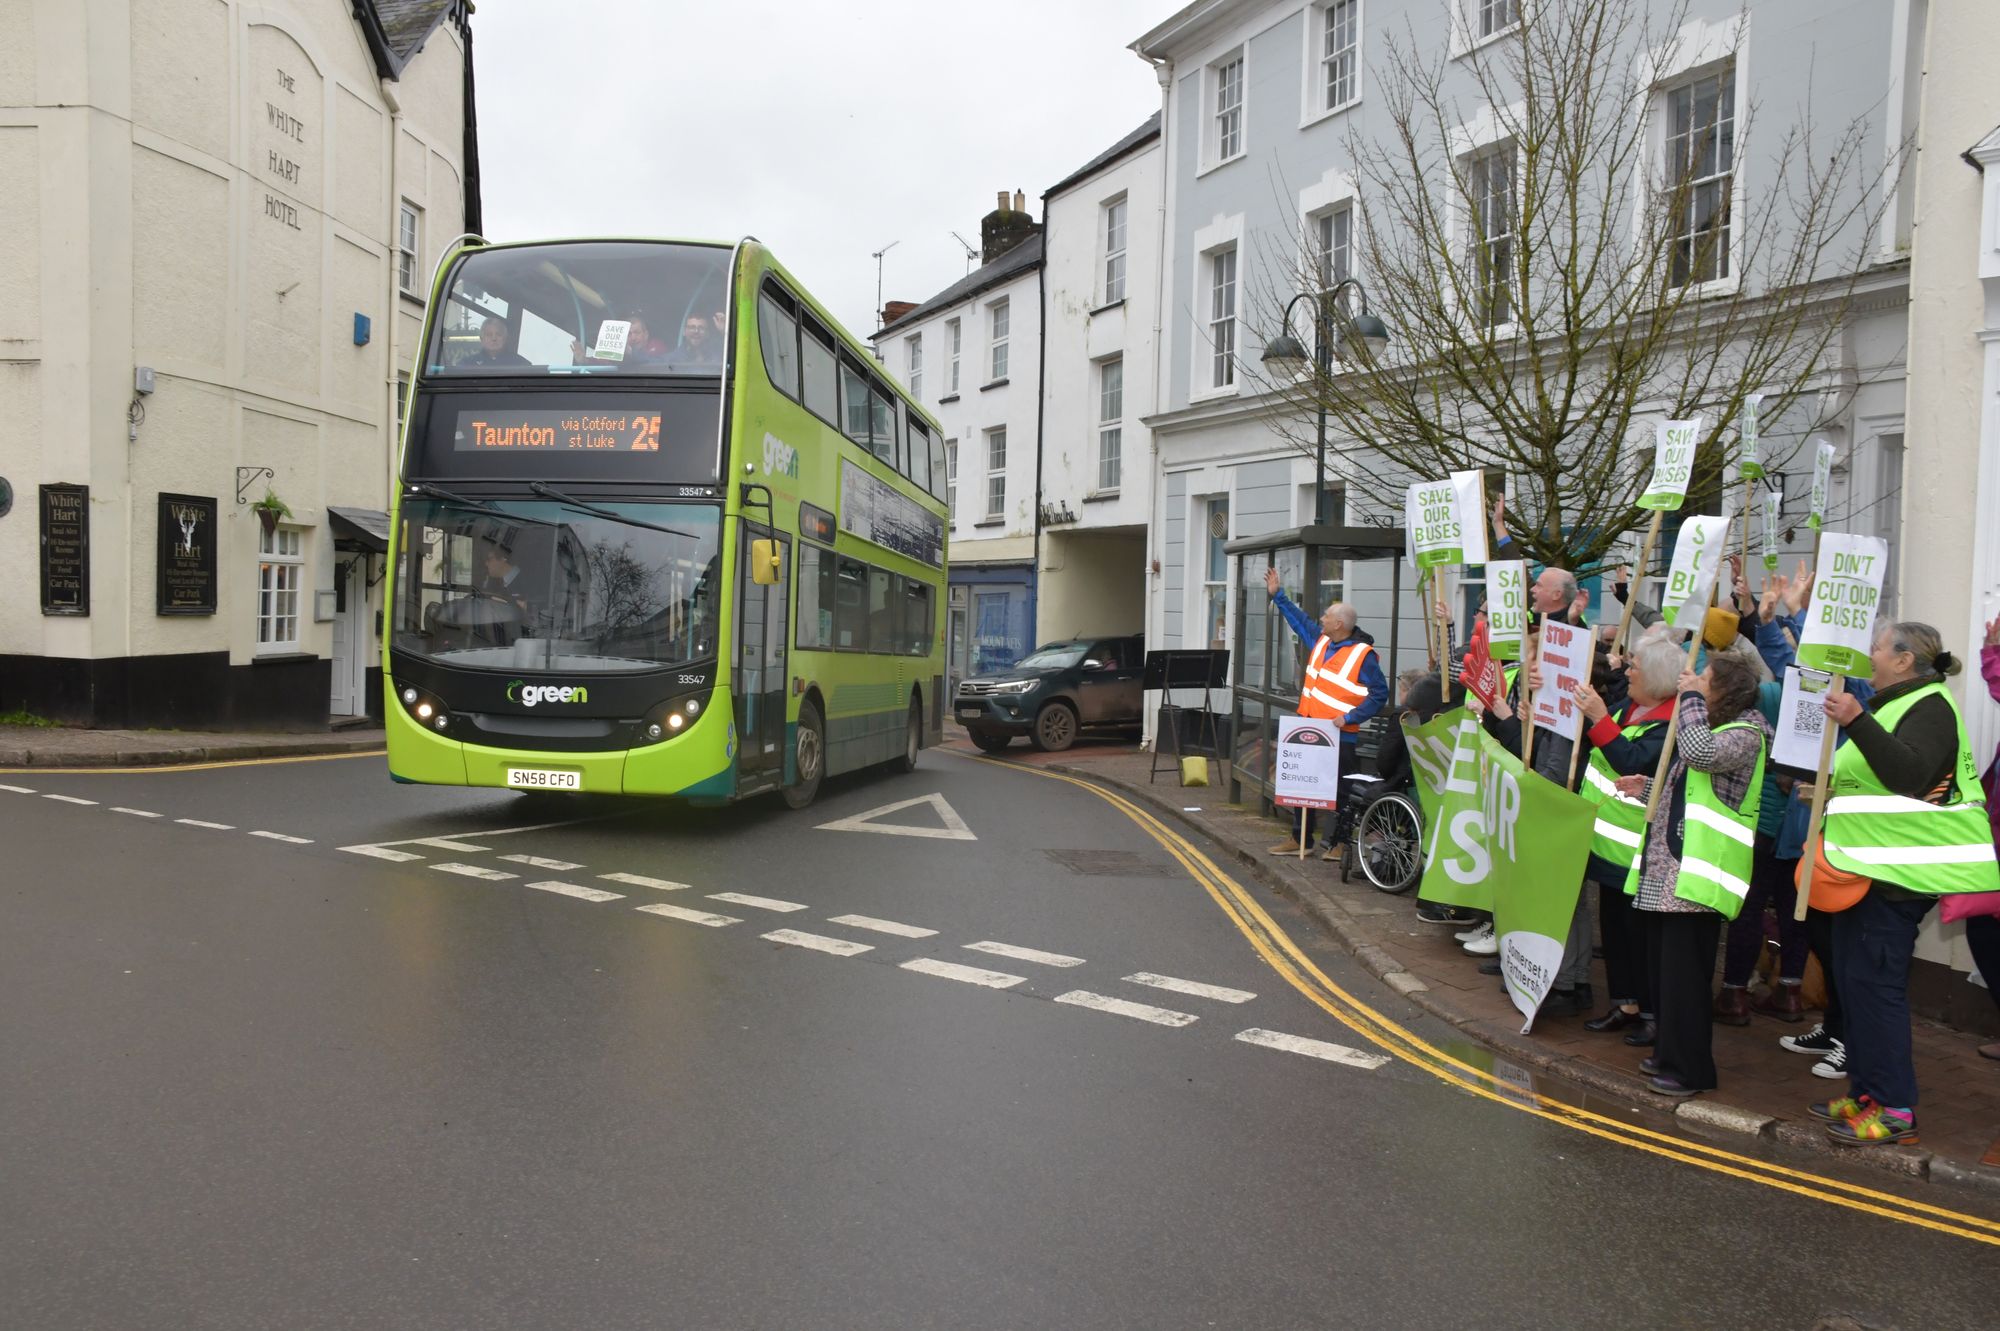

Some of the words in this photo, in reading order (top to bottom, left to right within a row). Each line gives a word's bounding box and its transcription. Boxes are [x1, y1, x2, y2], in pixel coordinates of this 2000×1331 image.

[277, 68, 295, 94] THE
[266, 102, 304, 143] WHITE
[269, 150, 301, 184] HART
[265, 194, 301, 231] HOTEL
[605, 325, 624, 334] SAVE
[605, 332, 621, 341] OUR
[599, 340, 624, 349] BUSES
[561, 417, 580, 431] via
[582, 416, 625, 431] Cotford
[472, 421, 555, 446] Taunton
[569, 434, 582, 448] st
[586, 434, 615, 448] Luke
[631, 416, 661, 450] 25
[763, 431, 798, 480] green
[1654, 465, 1689, 483] BUSES
[679, 487, 704, 496] 33547
[1418, 488, 1453, 506] SAVE
[50, 495, 80, 507] White
[53, 509, 76, 520] Hart
[1424, 506, 1450, 523] OUR
[1415, 522, 1461, 542] BUSES
[175, 542, 200, 557] Hart
[64, 579, 80, 588] Park
[1499, 570, 1521, 588] SA
[1849, 584, 1877, 608] OUR
[1492, 612, 1522, 629] BUS
[1820, 605, 1868, 630] BUSES
[1546, 624, 1573, 648] STOP
[678, 675, 705, 685] 33547
[522, 685, 588, 707] green
[1559, 696, 1573, 718] US
[513, 771, 546, 785] SN58
[1281, 772, 1319, 784] SERVICES
[1507, 938, 1541, 979] Somerset
